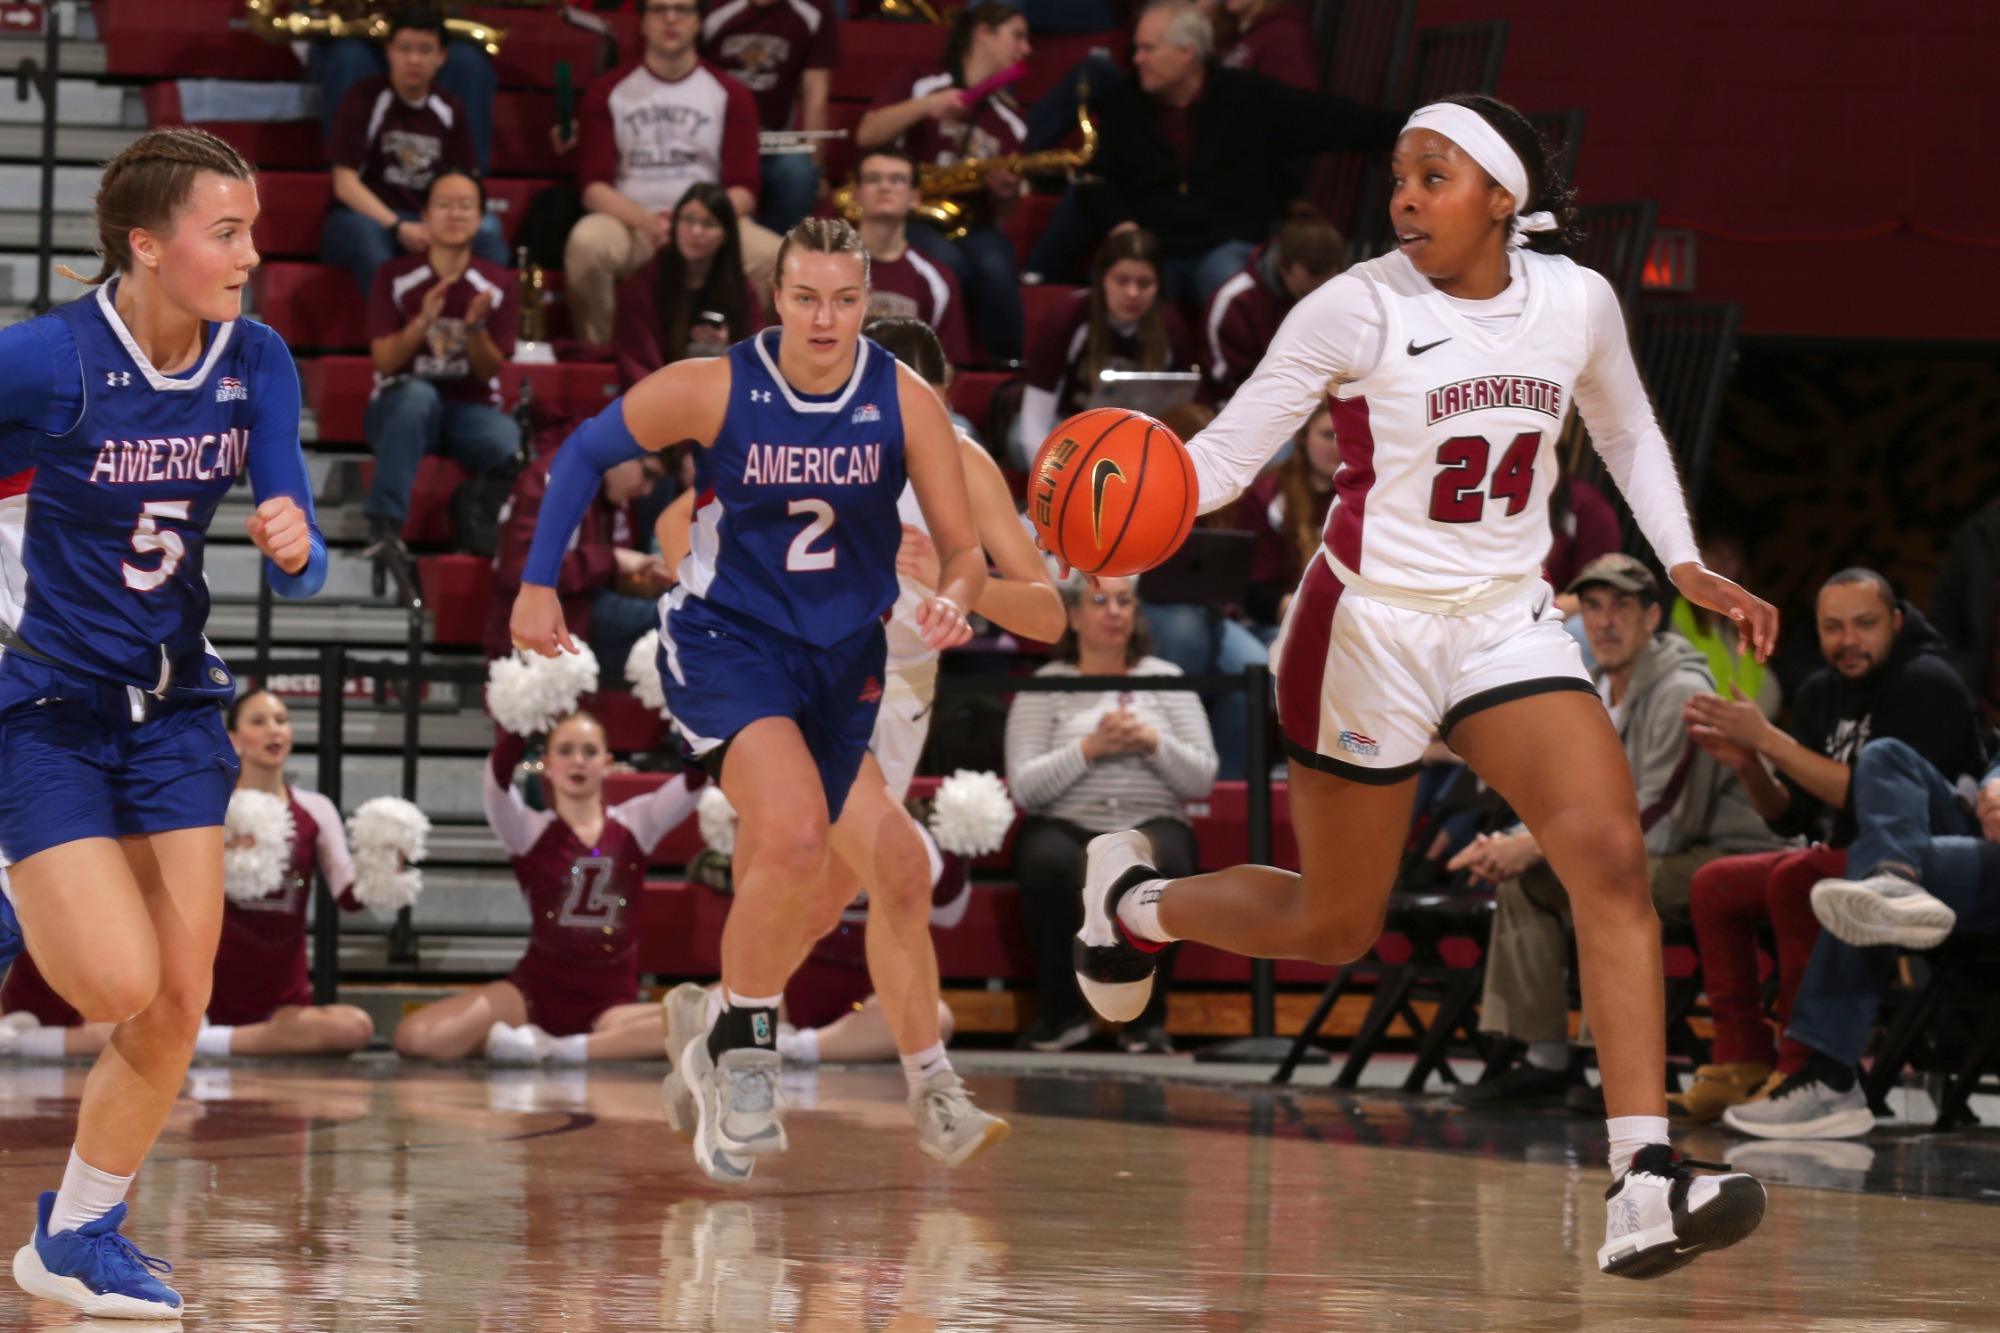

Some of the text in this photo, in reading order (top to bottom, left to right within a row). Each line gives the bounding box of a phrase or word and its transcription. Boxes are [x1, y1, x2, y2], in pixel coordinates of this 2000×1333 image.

[1427, 376, 1562, 426] LAFAYETTE
[89, 428, 249, 482] AMERICAN
[742, 442, 881, 485] AMERICAN
[1035, 437, 1080, 528] ELITE
[1428, 431, 1542, 523] 24
[122, 500, 191, 591] 5
[786, 498, 836, 571] 2
[559, 857, 620, 927] L
